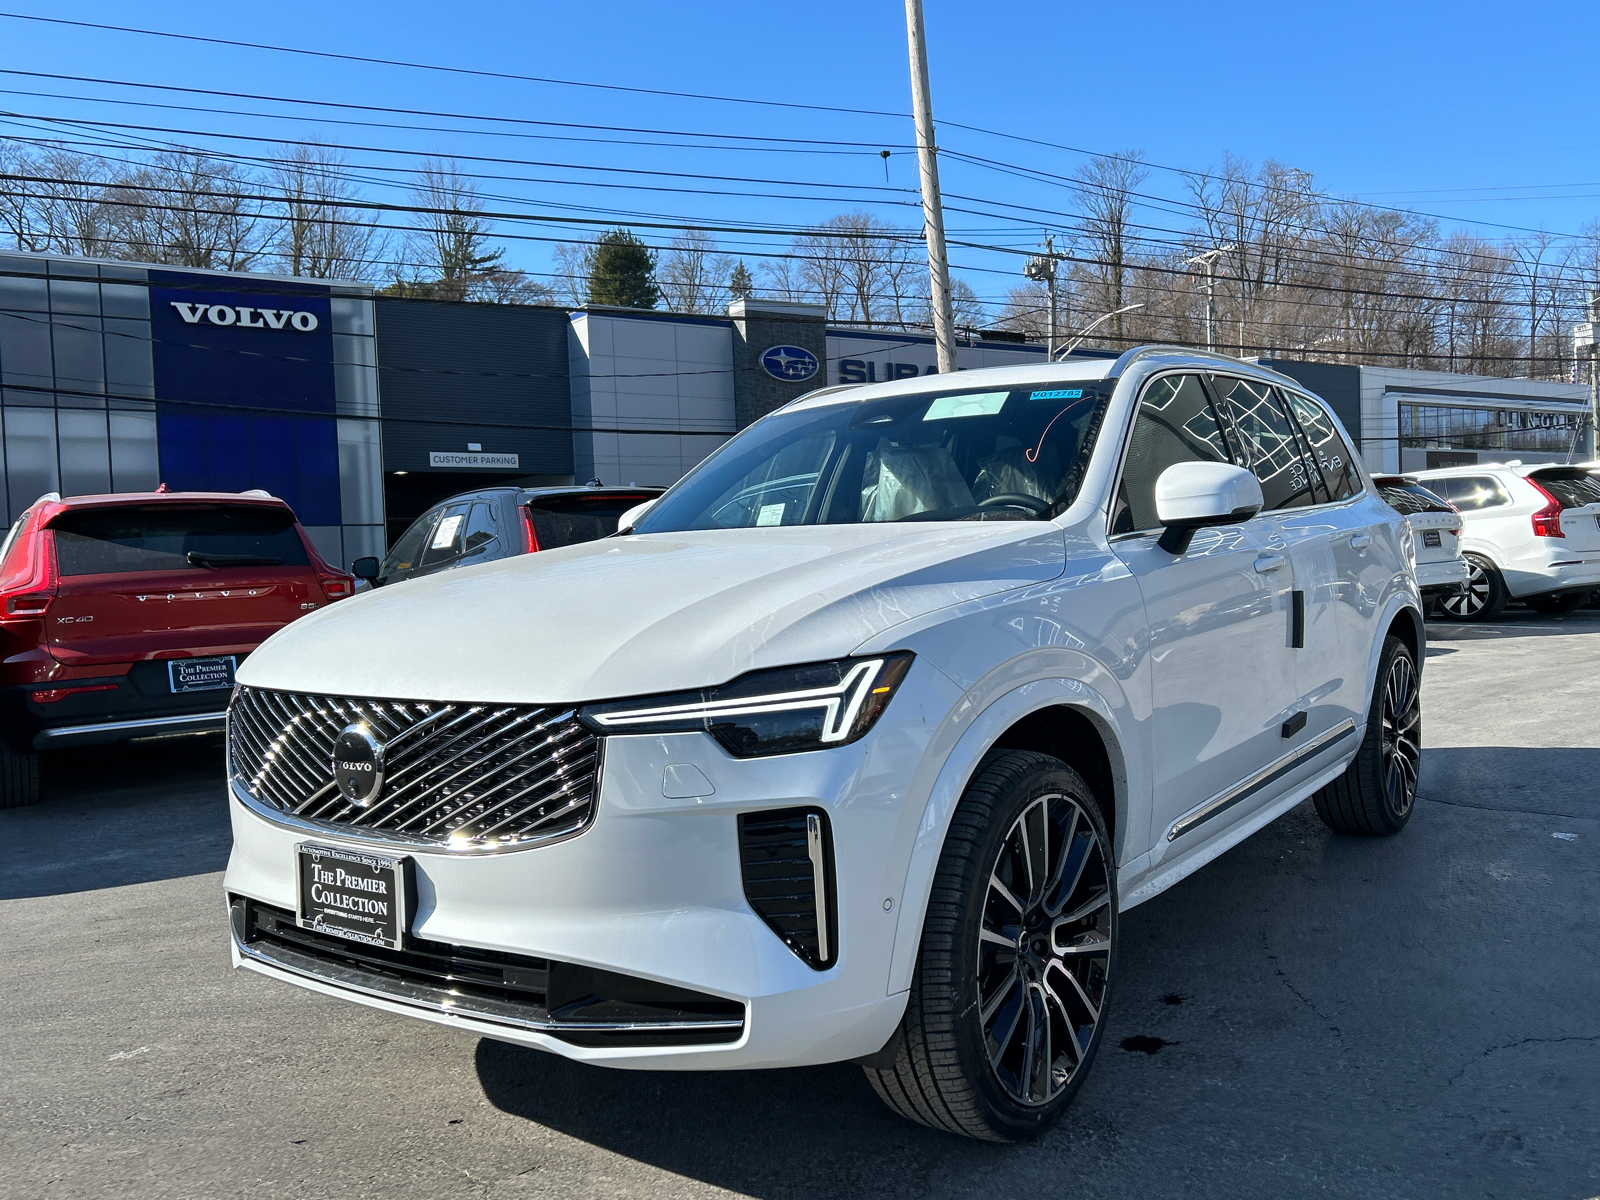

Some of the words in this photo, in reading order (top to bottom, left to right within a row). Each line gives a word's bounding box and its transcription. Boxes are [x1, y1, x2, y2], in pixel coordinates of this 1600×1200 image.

[170, 301, 318, 332] VOLVO
[840, 359, 967, 383] SUB
[433, 455, 479, 464] CUSTOMER
[481, 457, 517, 465] PARKING
[136, 590, 257, 602] VOLVO
[57, 615, 94, 624] XC40
[179, 672, 228, 682] COLLECTION
[311, 863, 335, 885] THE
[335, 868, 387, 894] PREMIER
[311, 883, 388, 916] COLLECTION
